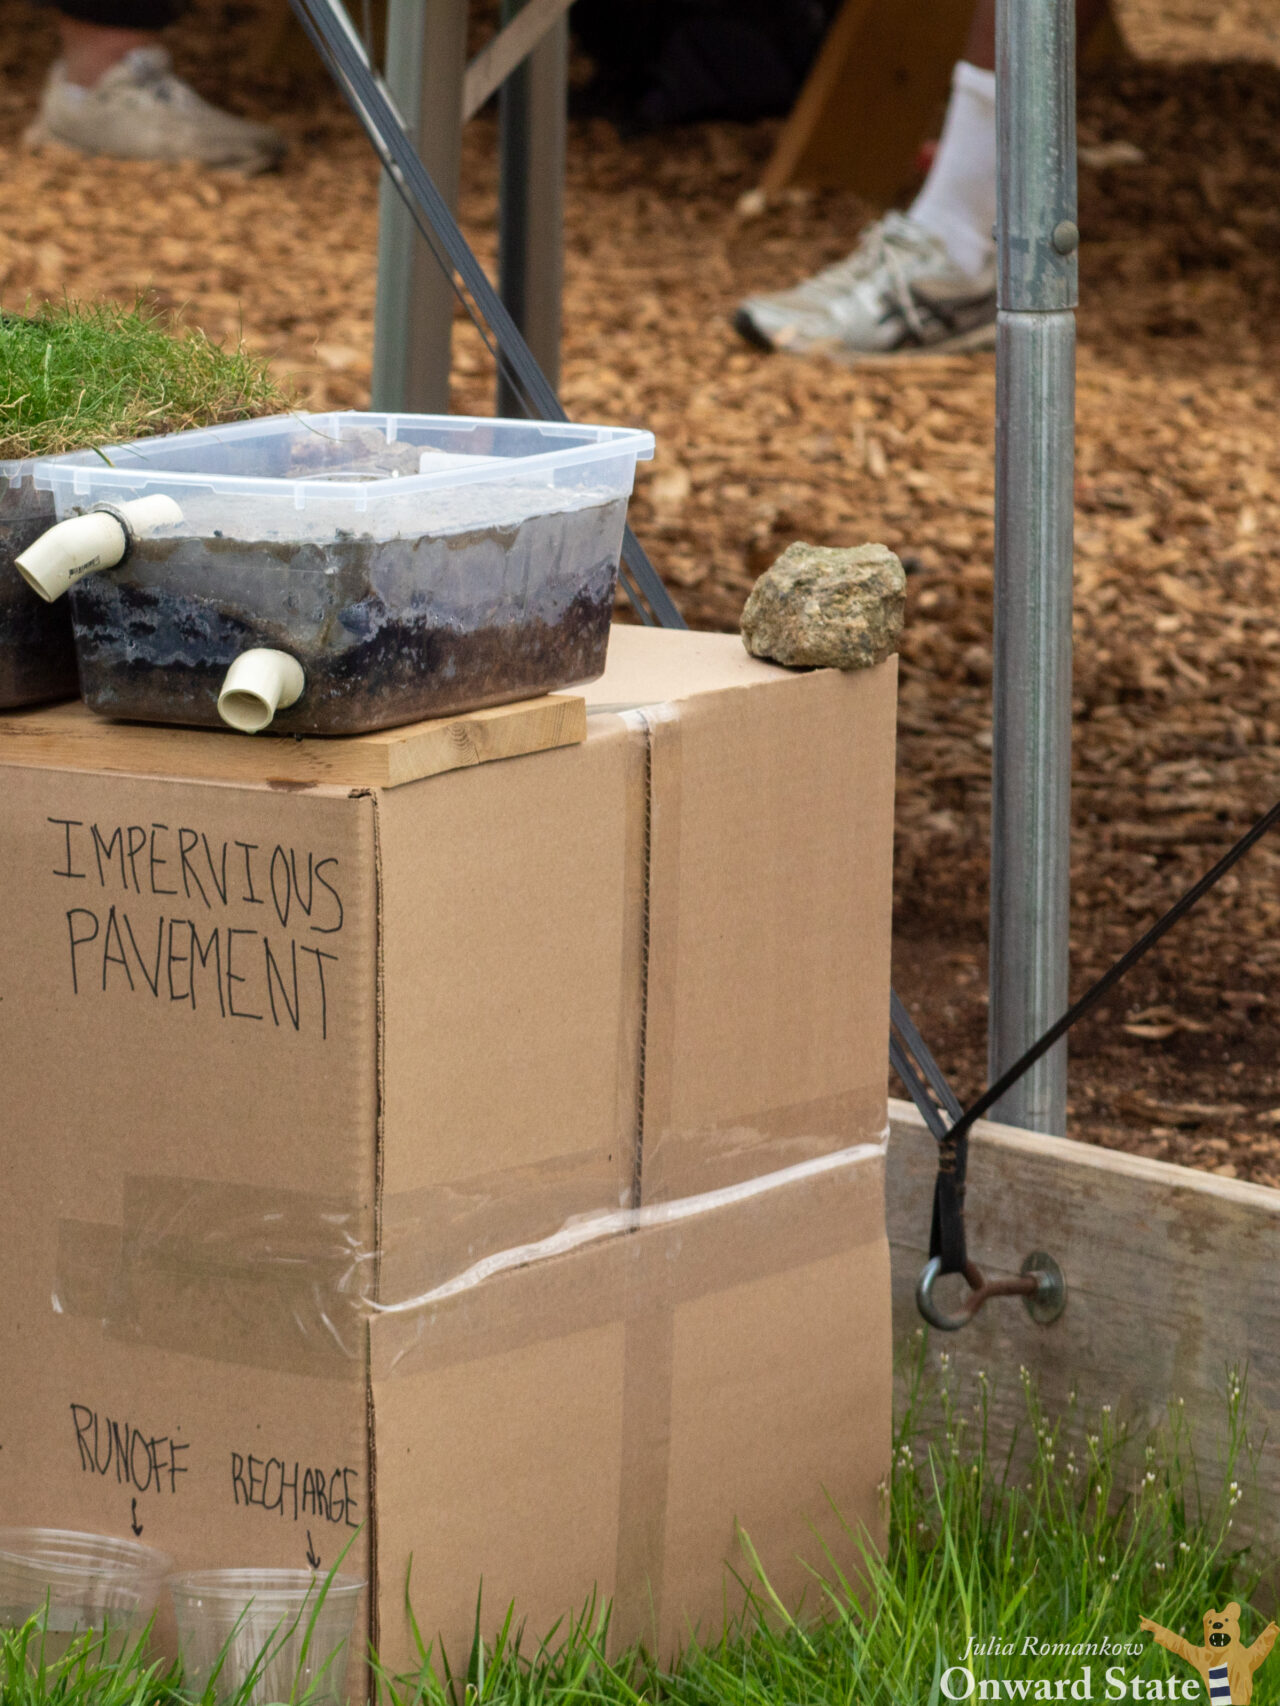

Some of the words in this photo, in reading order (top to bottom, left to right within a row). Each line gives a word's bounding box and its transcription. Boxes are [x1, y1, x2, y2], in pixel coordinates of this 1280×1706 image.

[47, 816, 344, 933] IMPERVIOUS
[66, 904, 339, 1041] PAVEMENT
[70, 1402, 190, 1493] RUNOFF
[231, 1452, 359, 1528] RECHARGE
